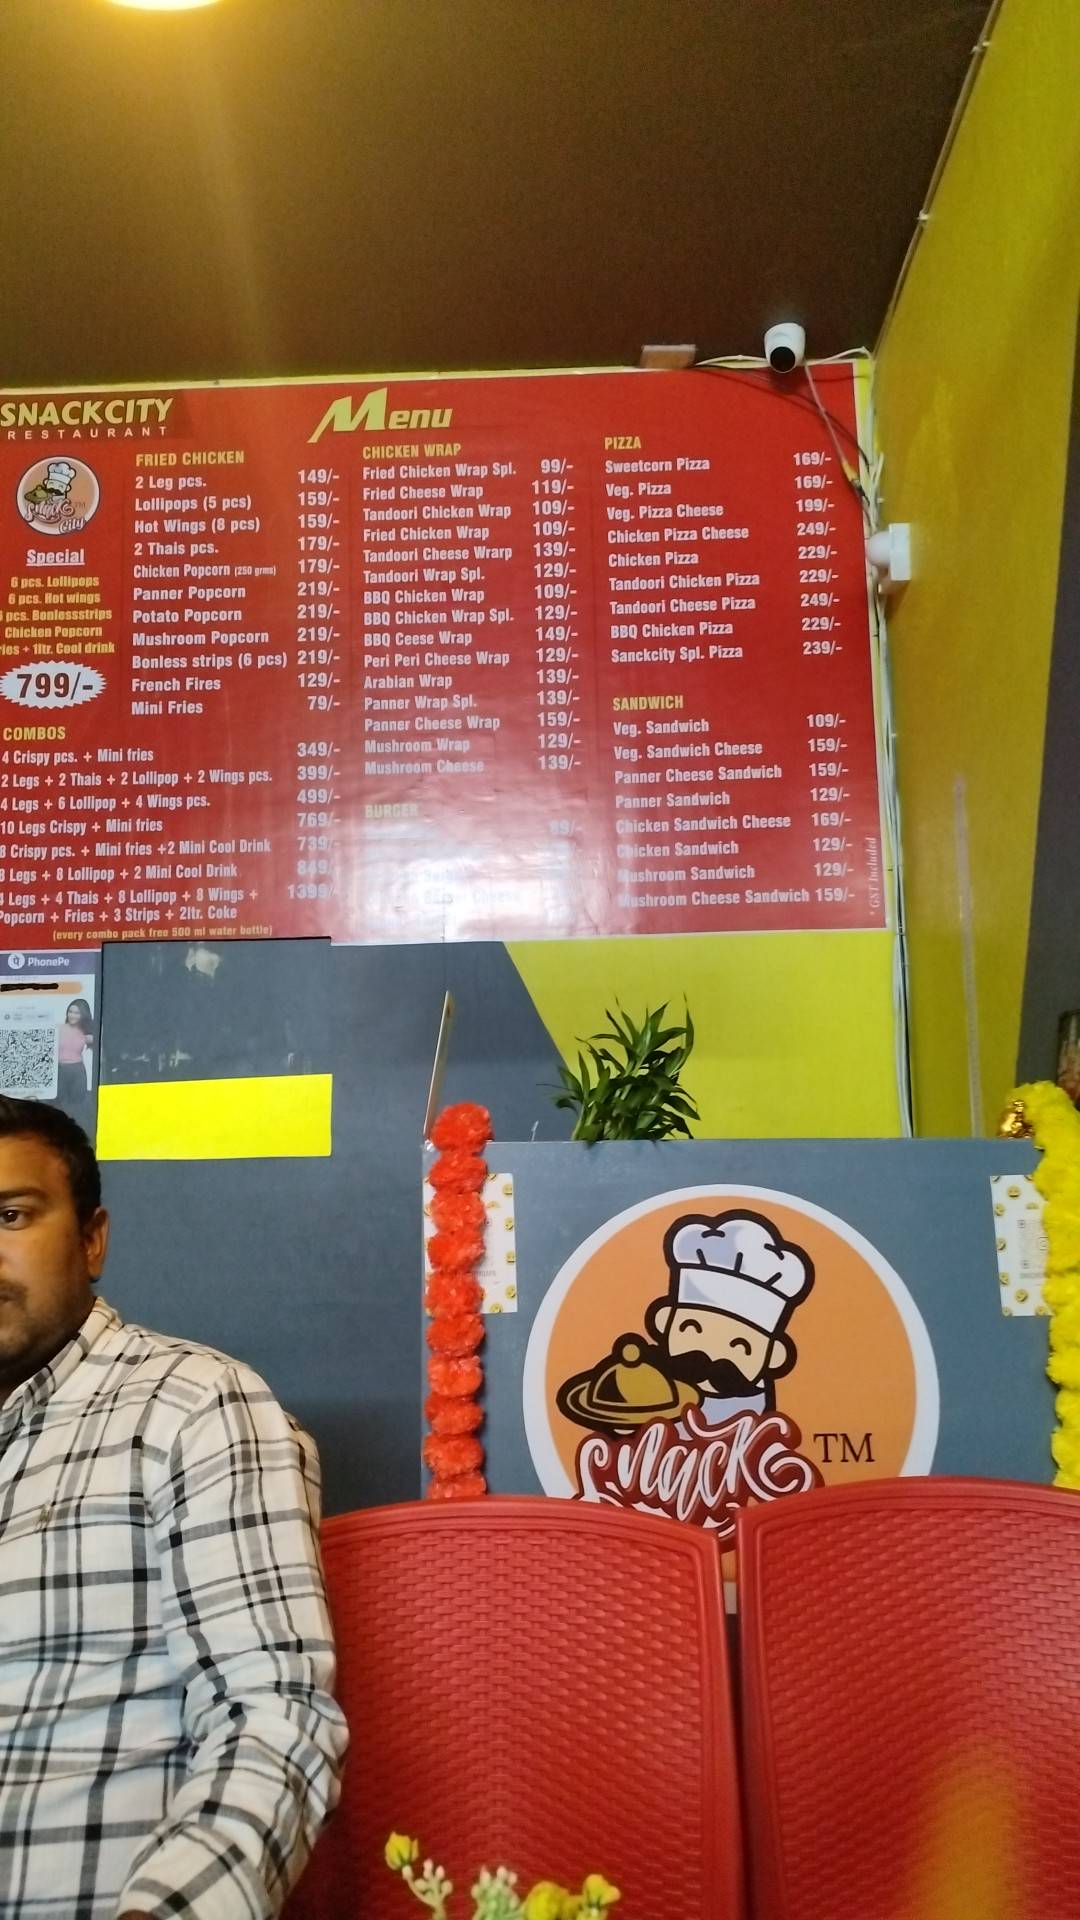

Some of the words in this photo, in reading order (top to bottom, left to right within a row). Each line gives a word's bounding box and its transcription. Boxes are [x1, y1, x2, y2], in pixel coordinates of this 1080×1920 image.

[0, 398, 173, 427] SNACKCITY
[307, 387, 453, 443] Menu
[7, 426, 168, 440] RESTAURANT
[605, 436, 641, 450] PIZZA
[136, 453, 177, 466] FRIED
[182, 450, 244, 465] CHICKEN
[363, 444, 419, 460] CHICKEN
[424, 443, 461, 457] WRAP
[793, 452, 831, 466] 169/-
[363, 466, 395, 480] Fried
[400, 464, 451, 479] Chicken
[455, 463, 488, 478] Wrap
[493, 462, 516, 478] Spl.
[541, 458, 573, 474] 99/-
[606, 459, 672, 473] Sweetcorn
[677, 457, 710, 471] Pizza
[136, 476, 144, 489] 2
[149, 475, 173, 491] Leg
[179, 477, 207, 490] pcs.
[298, 468, 339, 484] 149/-
[795, 475, 833, 489] 169/-
[363, 486, 395, 500] Fried
[400, 486, 446, 499] Cheese
[451, 484, 483, 499] Wrap
[532, 479, 574, 495] 119/-
[606, 483, 634, 499] Veg.
[638, 482, 671, 496] Pizza
[135, 497, 198, 513] Lollipops
[203, 496, 217, 512] (5
[223, 495, 251, 511] pcs)
[298, 491, 339, 506] 159/-
[796, 498, 834, 512] 199/-
[363, 506, 418, 521] Tandoori
[423, 505, 474, 519] Chicken
[478, 504, 511, 519] Wrap
[533, 499, 574, 516] 109/-
[607, 506, 635, 522] Veg.
[639, 505, 672, 519] Pizza
[677, 504, 724, 517] Cheese
[135, 520, 158, 533] Hot
[164, 519, 206, 535] Wings
[212, 518, 225, 534] (8
[231, 517, 260, 533] pcs)
[298, 513, 339, 529] 159/-
[533, 520, 575, 537] 109/-
[797, 521, 836, 536] 249/-
[364, 528, 396, 542] Fried
[400, 527, 452, 541] Chicken
[456, 525, 489, 541] Wrap
[608, 529, 660, 544] Chicken
[664, 528, 698, 541] Pizza
[702, 526, 749, 540] Cheese
[134, 542, 142, 556] 2
[148, 541, 185, 555] Thais
[190, 543, 219, 557] pcs.
[298, 535, 340, 551] 179/-
[534, 541, 576, 557] 139/-
[26, 549, 85, 566] Special
[363, 548, 418, 563] Tandoori
[423, 547, 469, 561] Cheese
[474, 546, 512, 561] Wrarp
[609, 553, 661, 567] Chicken
[665, 551, 699, 565] Pizza
[798, 545, 837, 559] 229/-
[134, 564, 179, 578] Chicken
[184, 563, 230, 579] Popcorn
[298, 558, 340, 574] 179/-
[534, 562, 576, 578] 129/-
[11, 576, 18, 588] 6
[21, 578, 44, 589] pcs.
[47, 575, 99, 588] Lollipops
[363, 569, 418, 584] Tandoori
[423, 568, 456, 583] Wrap
[461, 566, 485, 583] Spl.
[609, 576, 665, 591] Tandoori
[669, 574, 722, 588] Chicken
[726, 572, 760, 586] Pizza
[800, 569, 838, 583] 229/-
[134, 587, 183, 600] Panner
[189, 586, 246, 601] Popcorn
[298, 581, 340, 596] 219/-
[609, 599, 666, 615] Tandoori
[670, 599, 717, 612] Cheese
[722, 596, 756, 610] Pizza
[801, 592, 840, 607] 249/-
[133, 610, 179, 623] Potato
[185, 609, 242, 624] Popcorn
[297, 603, 340, 619] 219/-
[611, 624, 638, 639] BBQ
[642, 623, 695, 638] Chicken
[700, 622, 733, 635] Pizza
[802, 616, 841, 631] 229/-
[5, 626, 52, 638] Chicken
[55, 626, 102, 638] Popcorn
[133, 632, 206, 646] Mushroom
[212, 631, 269, 647] Popcorn
[298, 626, 340, 642] 219/-
[612, 647, 676, 663] Sanckcity
[680, 646, 705, 662] Spl.
[709, 645, 743, 659] Pizza
[803, 640, 842, 655] 239/-
[133, 655, 187, 669] Bonless
[192, 654, 233, 670] strips
[238, 653, 252, 669] (6
[258, 652, 287, 669] pcs)
[298, 649, 340, 665] 219/-
[17, 671, 94, 700] 799/-
[132, 678, 180, 692] French
[186, 677, 221, 691] Fires
[298, 672, 340, 688] 129/-
[132, 701, 162, 715] Mini
[168, 700, 203, 714] Fries
[613, 695, 683, 711] SANDWICH
[613, 721, 641, 738] Veg.
[646, 718, 709, 734] Sandwich
[807, 713, 846, 728] 109/-
[3, 726, 66, 741] COMBOS
[297, 741, 340, 758] 349/-
[614, 746, 642, 762] Veg.
[647, 743, 710, 759] Sandwich
[715, 742, 762, 756] Cheese
[808, 737, 847, 752] 159/-
[2, 751, 9, 764] 4
[14, 750, 50, 766] Crispy
[54, 752, 77, 766] pcs.
[83, 752, 92, 762] +
[98, 748, 123, 762] Mini
[127, 748, 154, 761] fries
[615, 770, 662, 785] Panner
[666, 768, 714, 782] Cheese
[718, 764, 782, 780] Sandwich
[809, 762, 849, 777] 159/-
[615, 793, 662, 808] Panner
[667, 791, 730, 807] Sandwich
[811, 787, 850, 802] 129/-
[53, 930, 83, 941] (every
[86, 929, 118, 939] combo
[122, 928, 146, 940] pack
[149, 927, 169, 938] free
[172, 926, 191, 937] 500
[193, 926, 206, 936] ml
[209, 925, 238, 936] water
[239, 923, 272, 937] bottle)
[28, 957, 70, 967] PhonePe
[813, 1432, 875, 1463] TM
